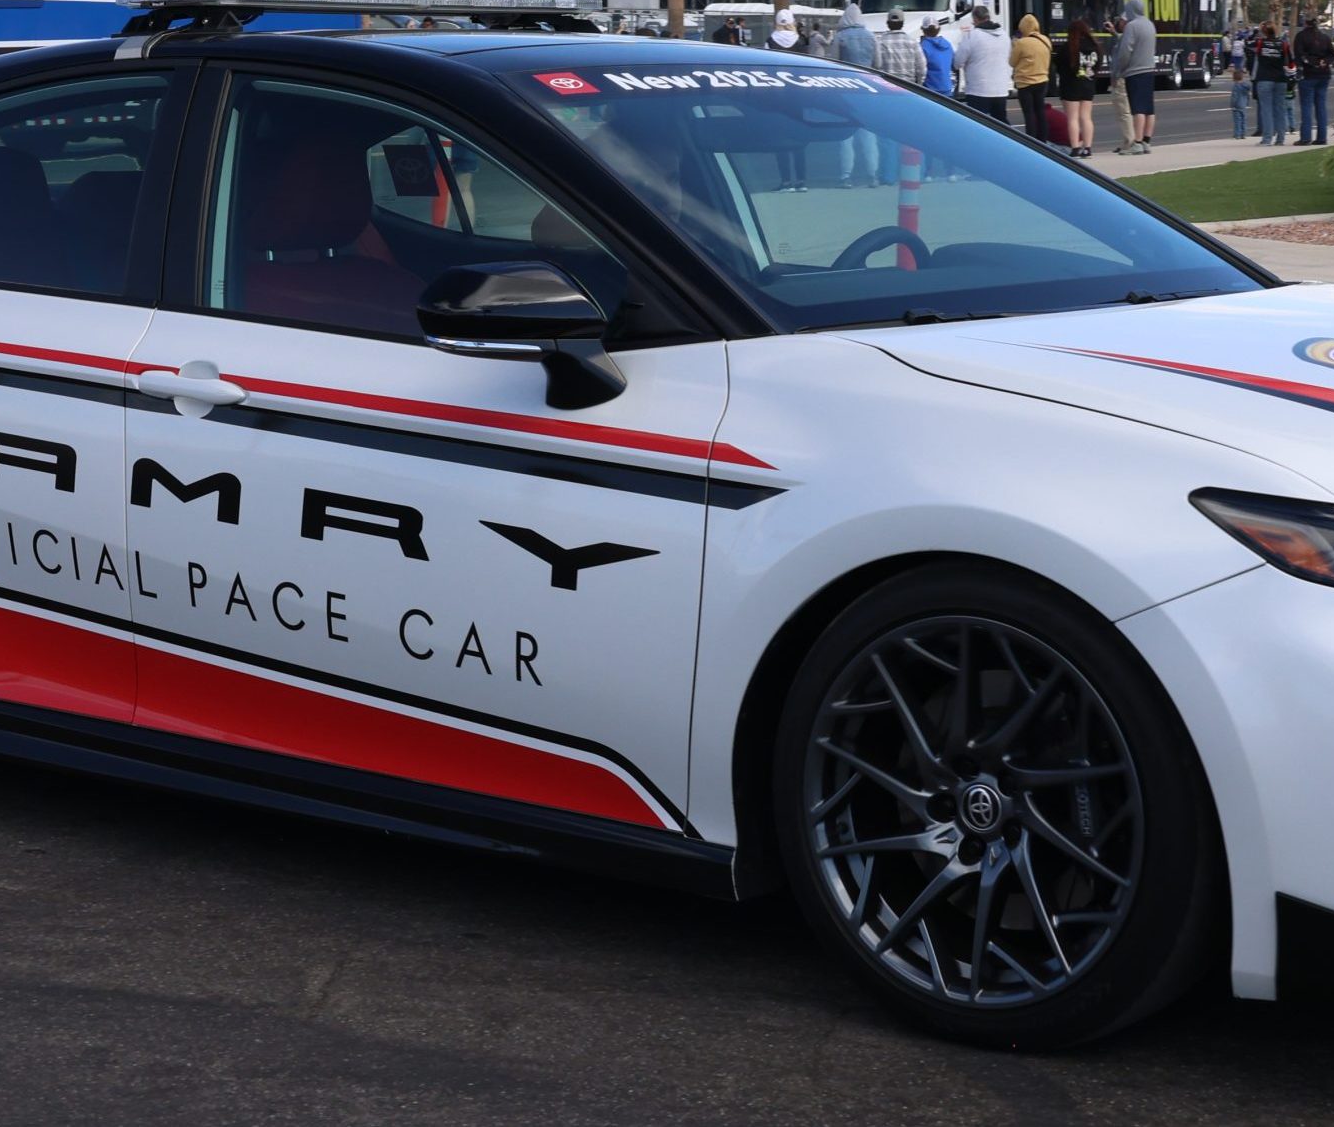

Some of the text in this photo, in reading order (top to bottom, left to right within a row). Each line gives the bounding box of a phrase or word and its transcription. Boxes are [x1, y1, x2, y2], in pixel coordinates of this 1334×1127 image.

[603, 71, 880, 94] New 2025 Camry
[187, 560, 350, 643] PACE
[399, 609, 544, 687] CAR
